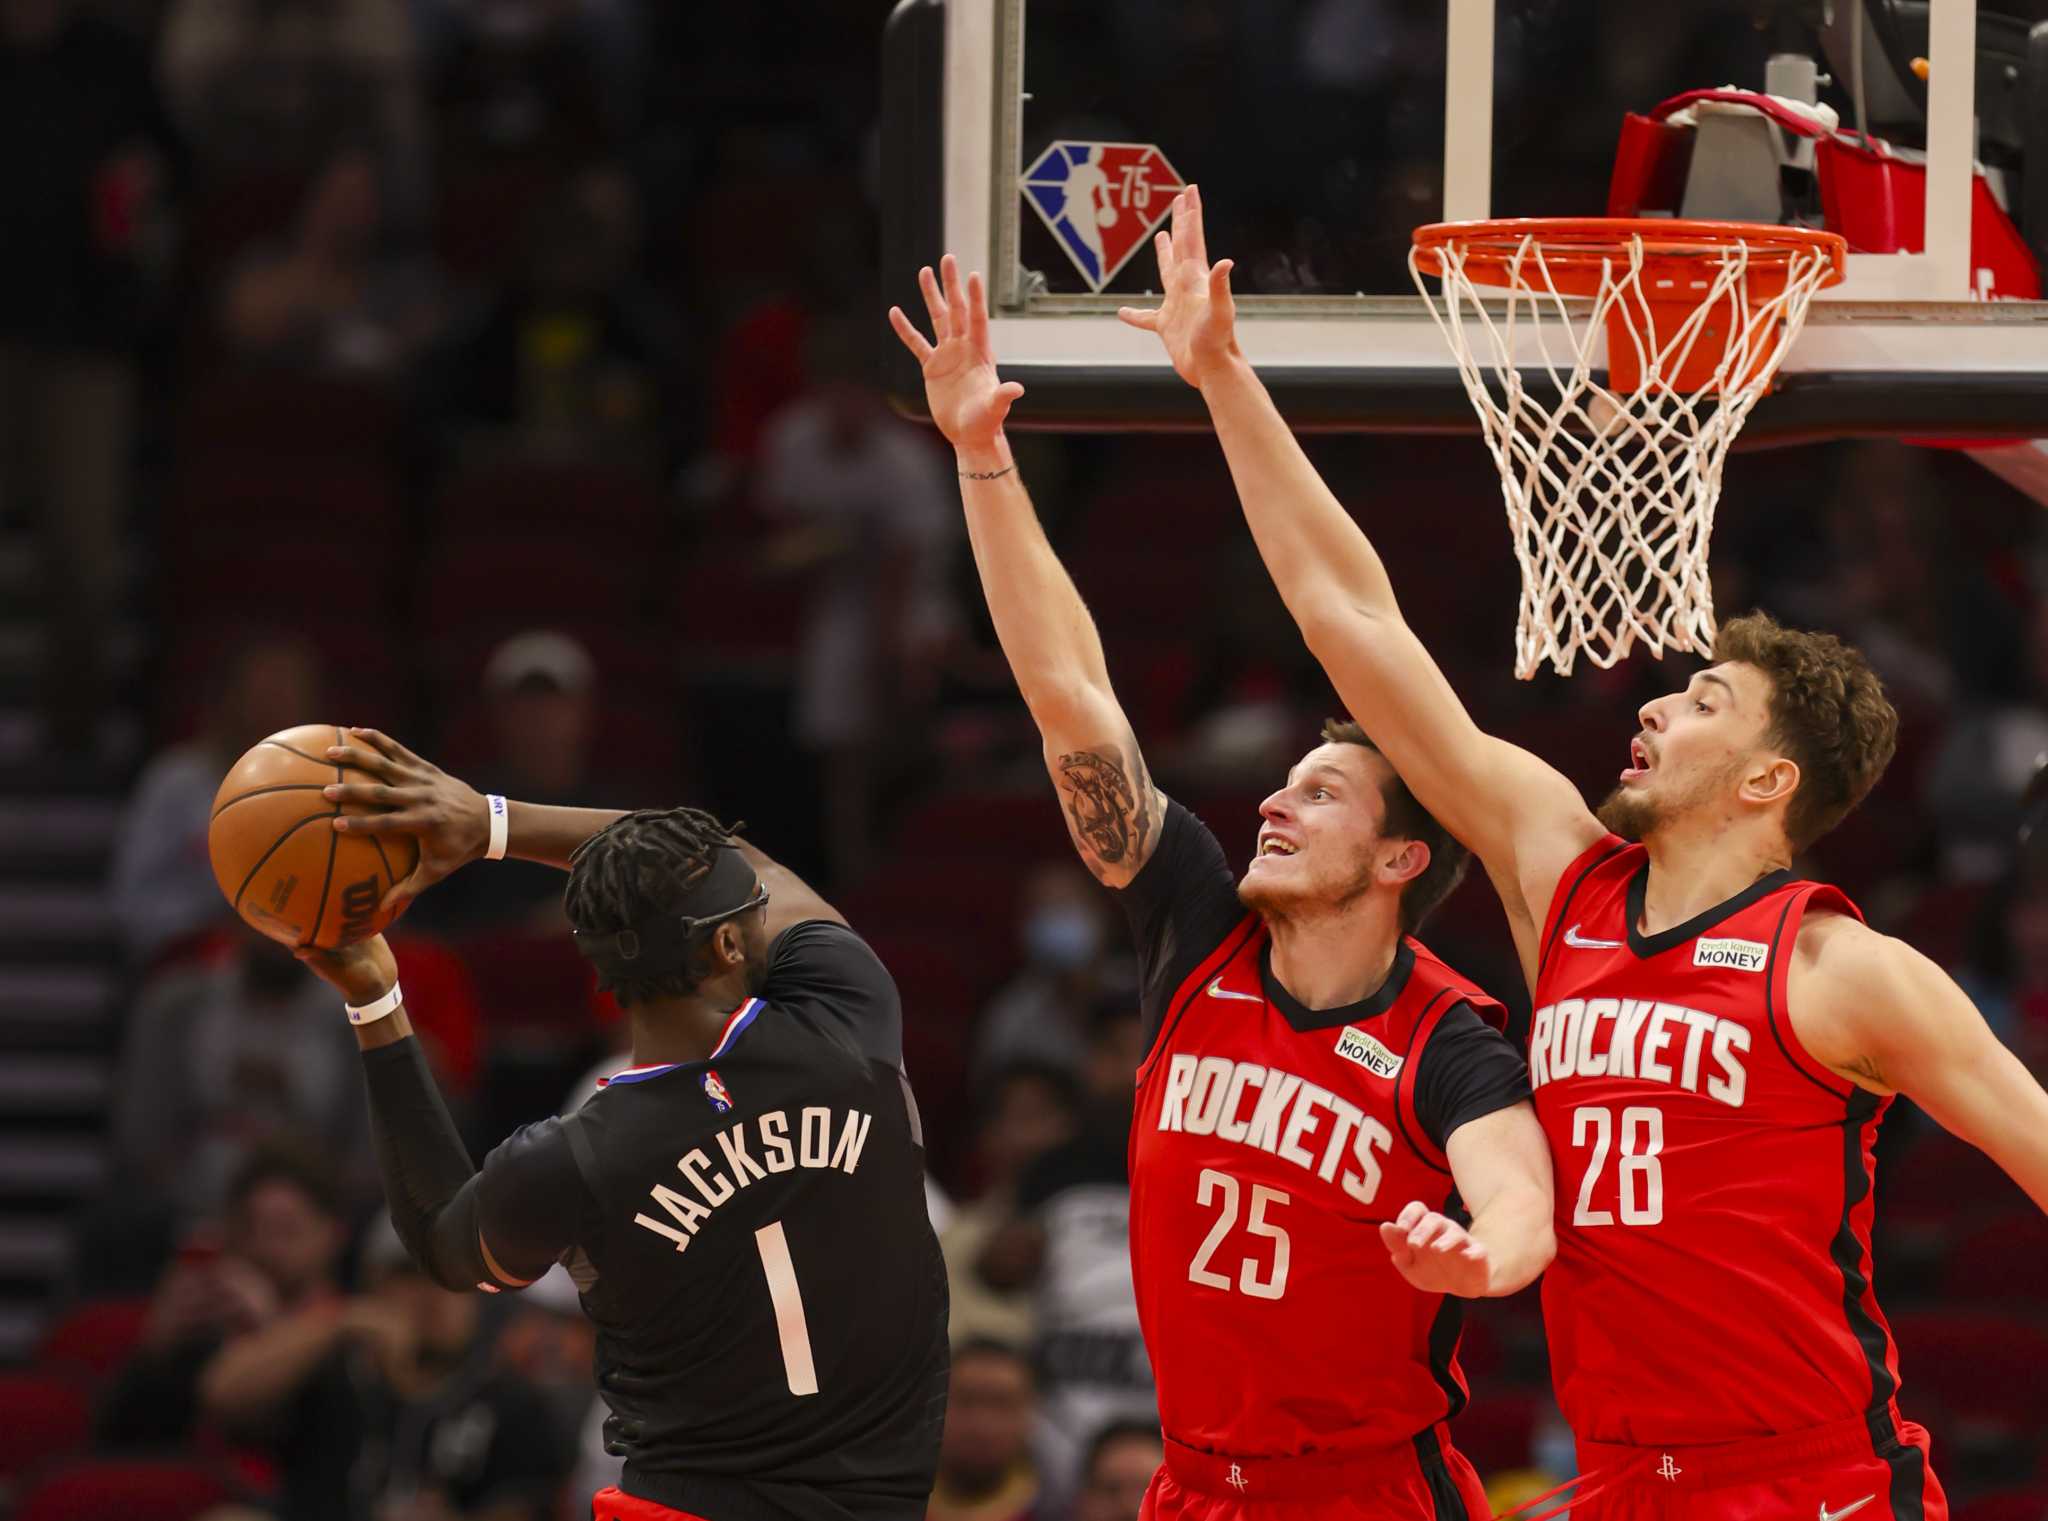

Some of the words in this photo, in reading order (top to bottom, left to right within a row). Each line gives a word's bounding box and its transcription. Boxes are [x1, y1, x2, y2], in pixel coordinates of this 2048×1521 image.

[1120, 166, 1151, 208] 75
[1698, 951, 1762, 968] MONEY
[1339, 1039, 1395, 1075] MONEY
[1531, 998, 1751, 1108] ROCKETS
[633, 1106, 872, 1253] JACKSON
[1157, 1053, 1393, 1205] ROCKETS
[1572, 1107, 1663, 1226] 28
[1188, 1168, 1291, 1300] 25
[754, 1220, 819, 1396] 1
